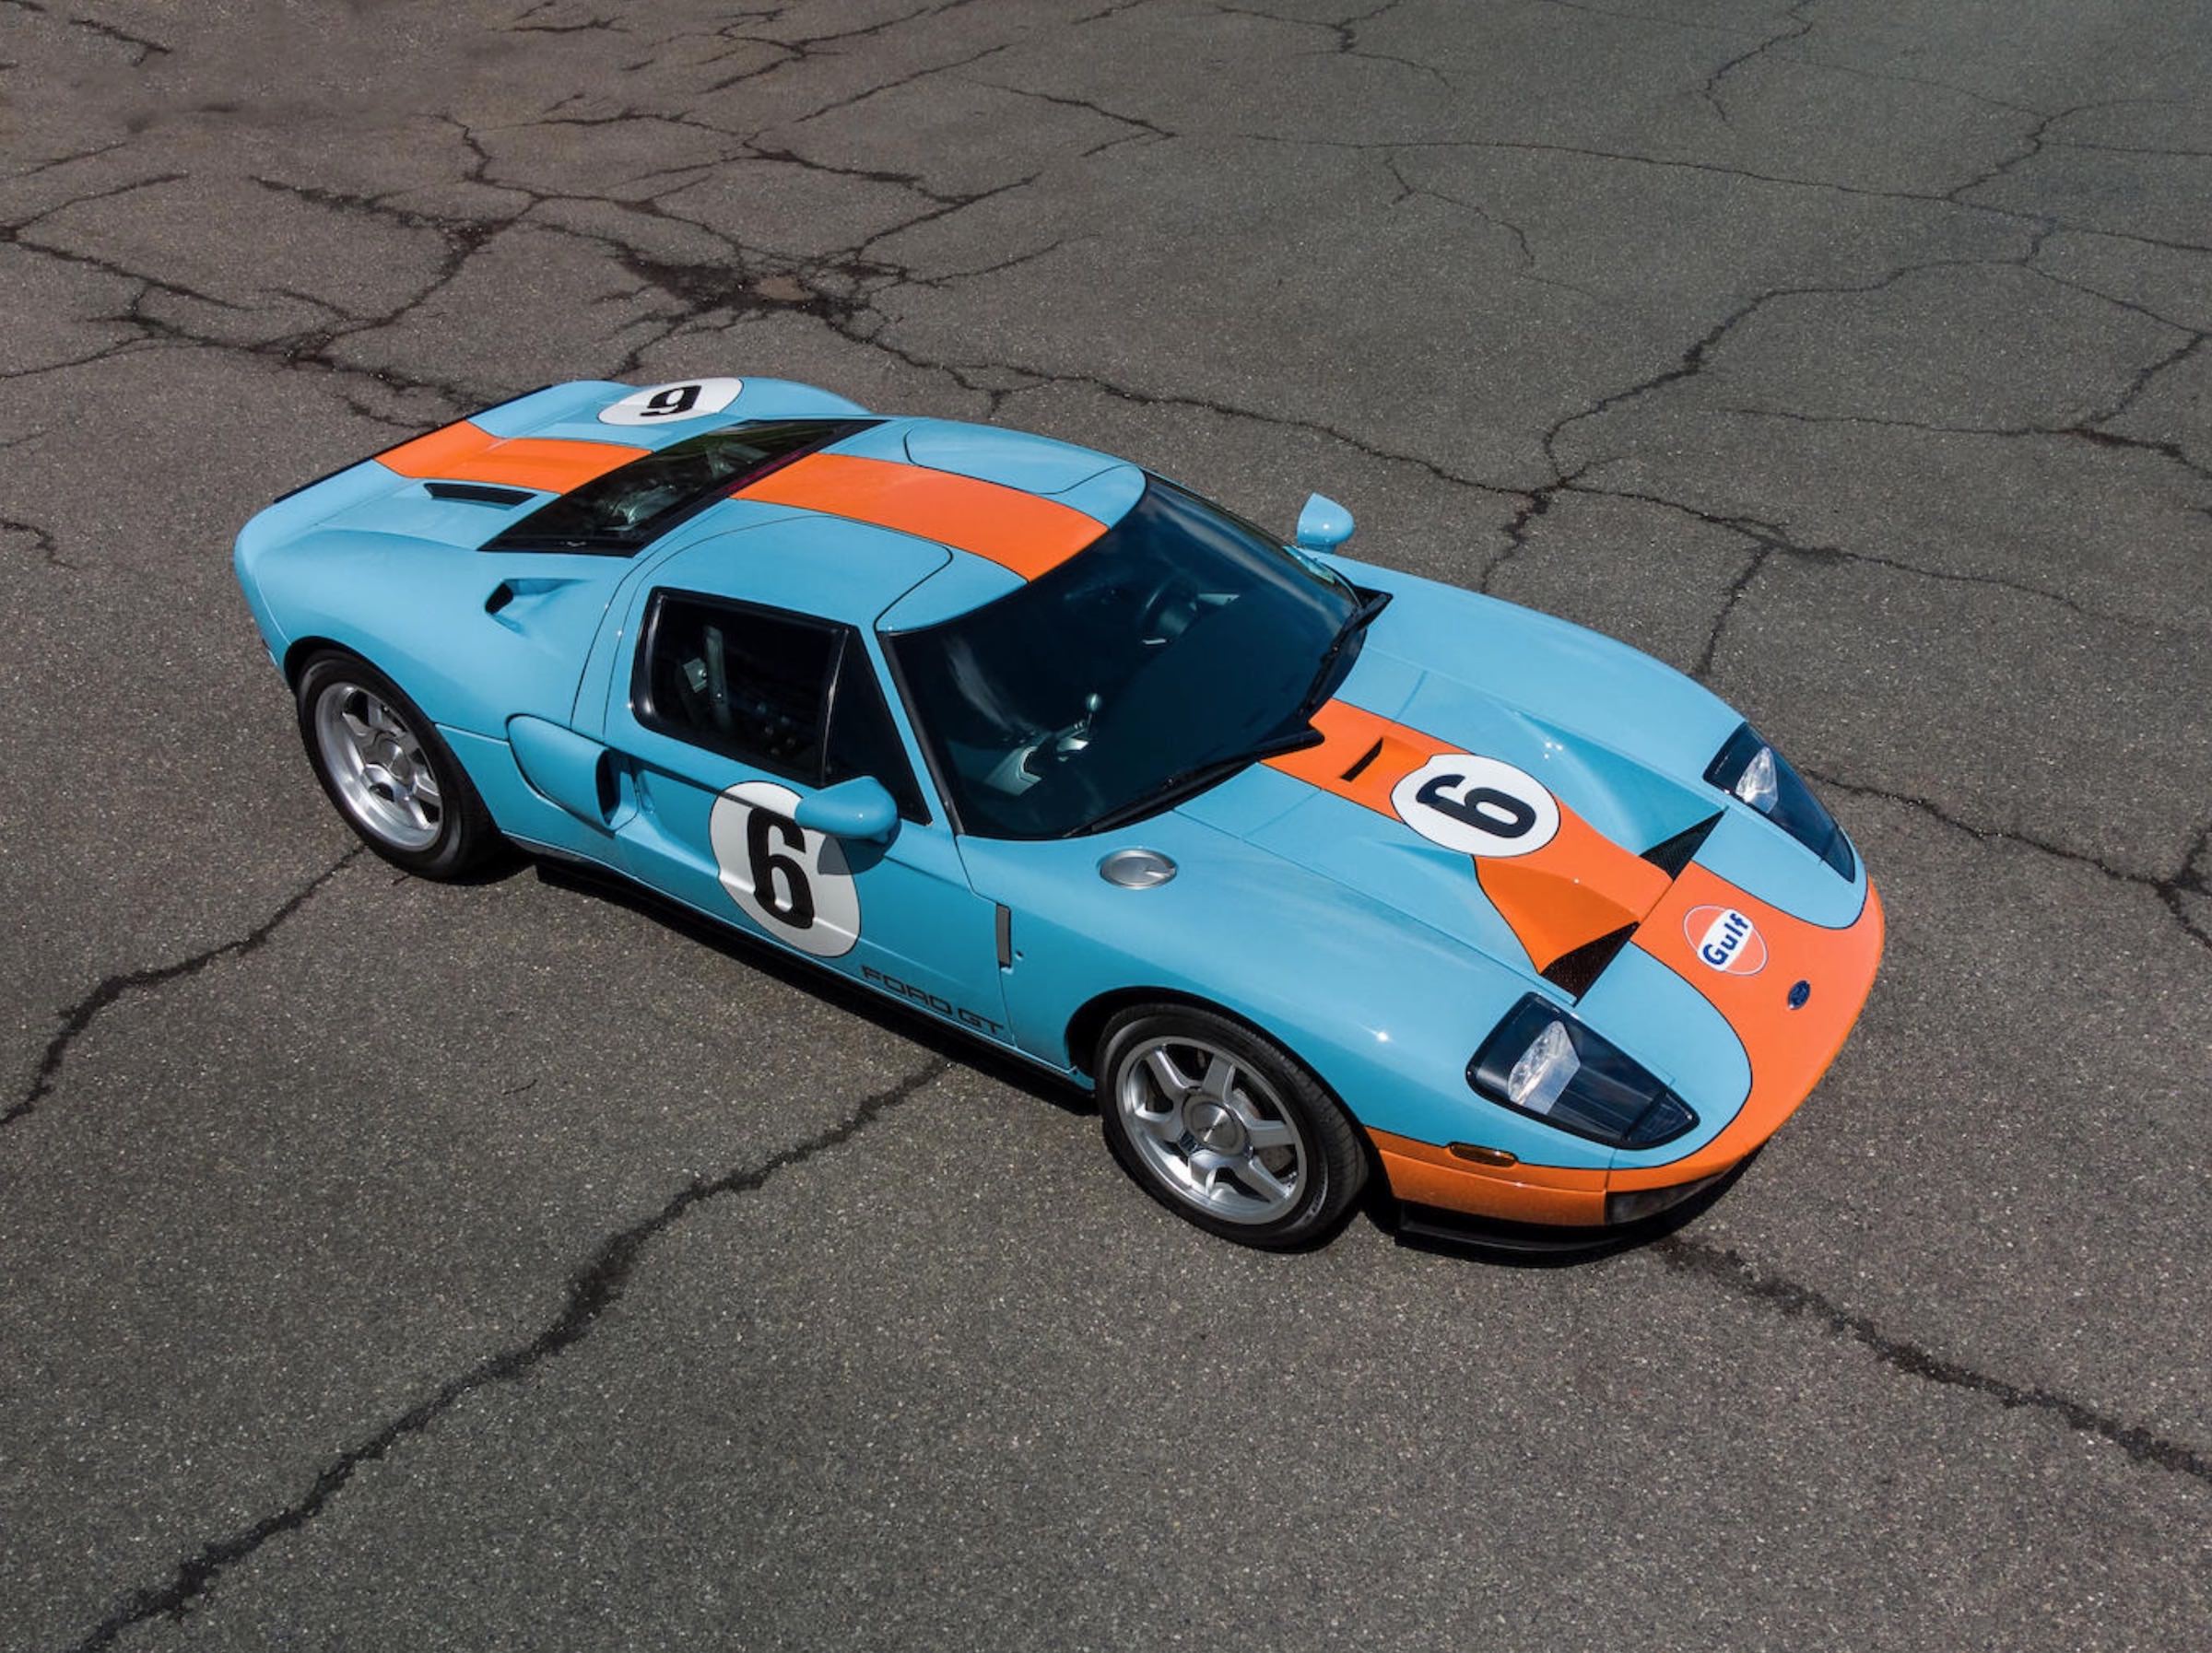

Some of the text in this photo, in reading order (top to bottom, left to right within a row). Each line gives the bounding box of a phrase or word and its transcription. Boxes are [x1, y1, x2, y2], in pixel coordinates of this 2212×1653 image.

[1416, 774, 1536, 838] 6
[747, 807, 815, 930] 6
[1702, 913, 1748, 966] Gulf
[861, 965, 1004, 1036] FORD GT
